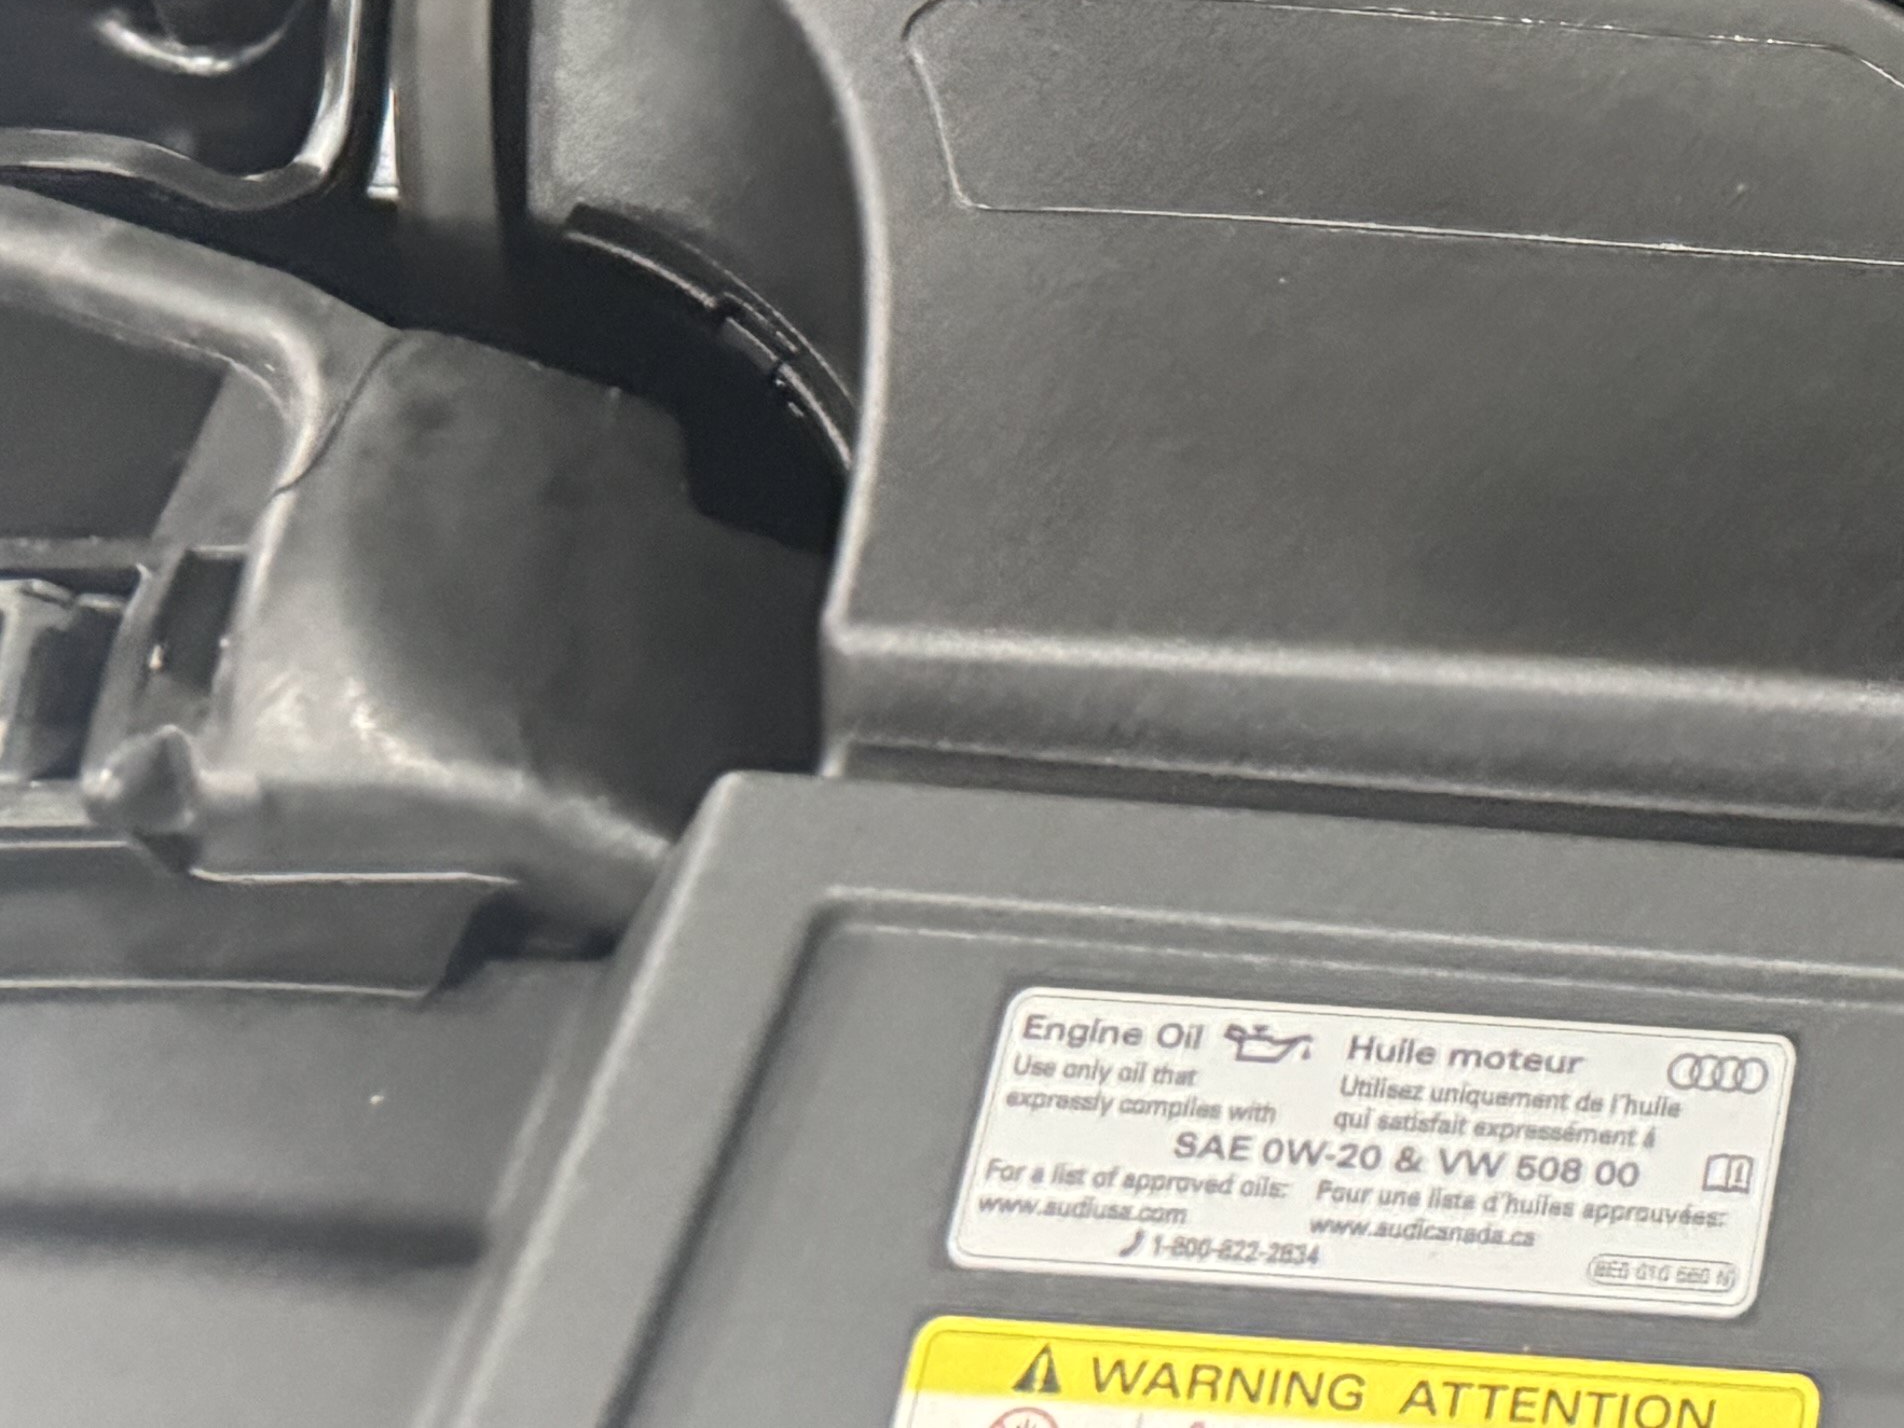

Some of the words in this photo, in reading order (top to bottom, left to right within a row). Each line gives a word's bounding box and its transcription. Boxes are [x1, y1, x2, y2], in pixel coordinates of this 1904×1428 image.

[1022, 1014, 1143, 1049] Engine
[1156, 1021, 1205, 1050] Oil
[1012, 1052, 1057, 1077] Use
[1062, 1056, 1111, 1085] only
[1118, 1060, 1147, 1083] oil
[1152, 1062, 1198, 1086] that
[1347, 1033, 1437, 1067] Huile
[1447, 1046, 1585, 1075] moteur
[1006, 1090, 1114, 1118] expressly
[1119, 1095, 1222, 1126] complies
[1229, 1100, 1277, 1125] with
[1340, 1075, 1424, 1101] Utilisez
[1430, 1083, 1571, 1112] uniquement
[1575, 1087, 1605, 1113] de
[1610, 1090, 1682, 1119] l'huile
[1334, 1107, 1371, 1132] qui
[1377, 1110, 1468, 1136] satisfait
[1474, 1115, 1635, 1146] expressément
[986, 1157, 1028, 1183] For
[1030, 1165, 1045, 1185] a
[1051, 1160, 1086, 1185] list
[1092, 1162, 1118, 1188] of
[1121, 1164, 1233, 1197] approved
[1173, 1130, 1253, 1162] SAE
[1262, 1137, 1383, 1172] 0W-20
[1394, 1144, 1423, 1174] &
[1438, 1147, 1507, 1178] VW
[1515, 1154, 1582, 1185] 508
[1594, 1158, 1640, 1188] 00
[977, 1194, 1189, 1226] www.audiusa.com
[1316, 1179, 1374, 1208] Pour
[1377, 1188, 1422, 1210] une
[1427, 1186, 1477, 1213] liste
[1482, 1189, 1576, 1219] d'huiles
[1309, 1217, 1537, 1248] www.audicanada.ca
[1093, 1355, 1366, 1413] WARNING
[1399, 1376, 1717, 1428] ATTENTION
